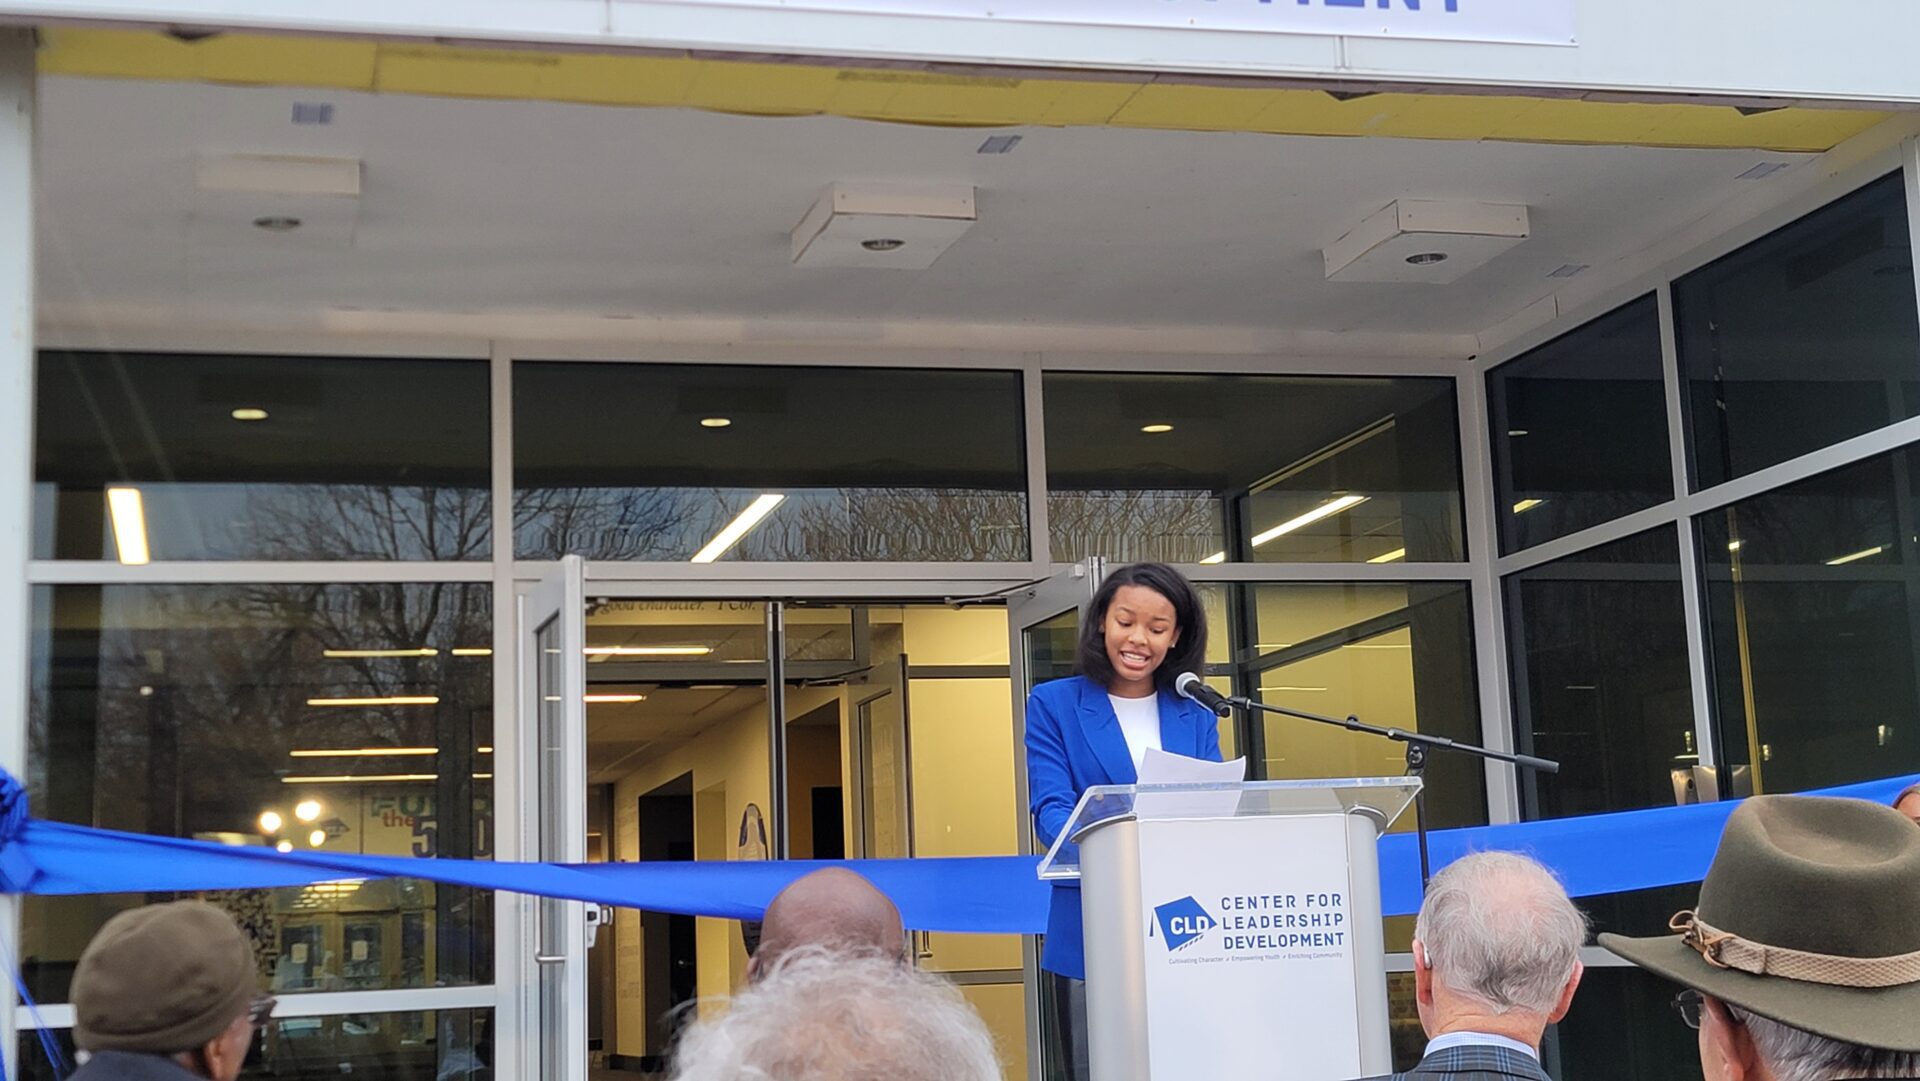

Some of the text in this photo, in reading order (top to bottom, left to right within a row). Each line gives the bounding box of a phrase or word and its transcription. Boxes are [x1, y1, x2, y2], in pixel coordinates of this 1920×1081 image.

[383, 809, 416, 827] the
[1221, 894, 1341, 910] CENTER FOR
[1170, 915, 1209, 935] CLD
[1222, 913, 1343, 930] LEADERSHIP
[1224, 932, 1344, 949] DEVELOPMENT
